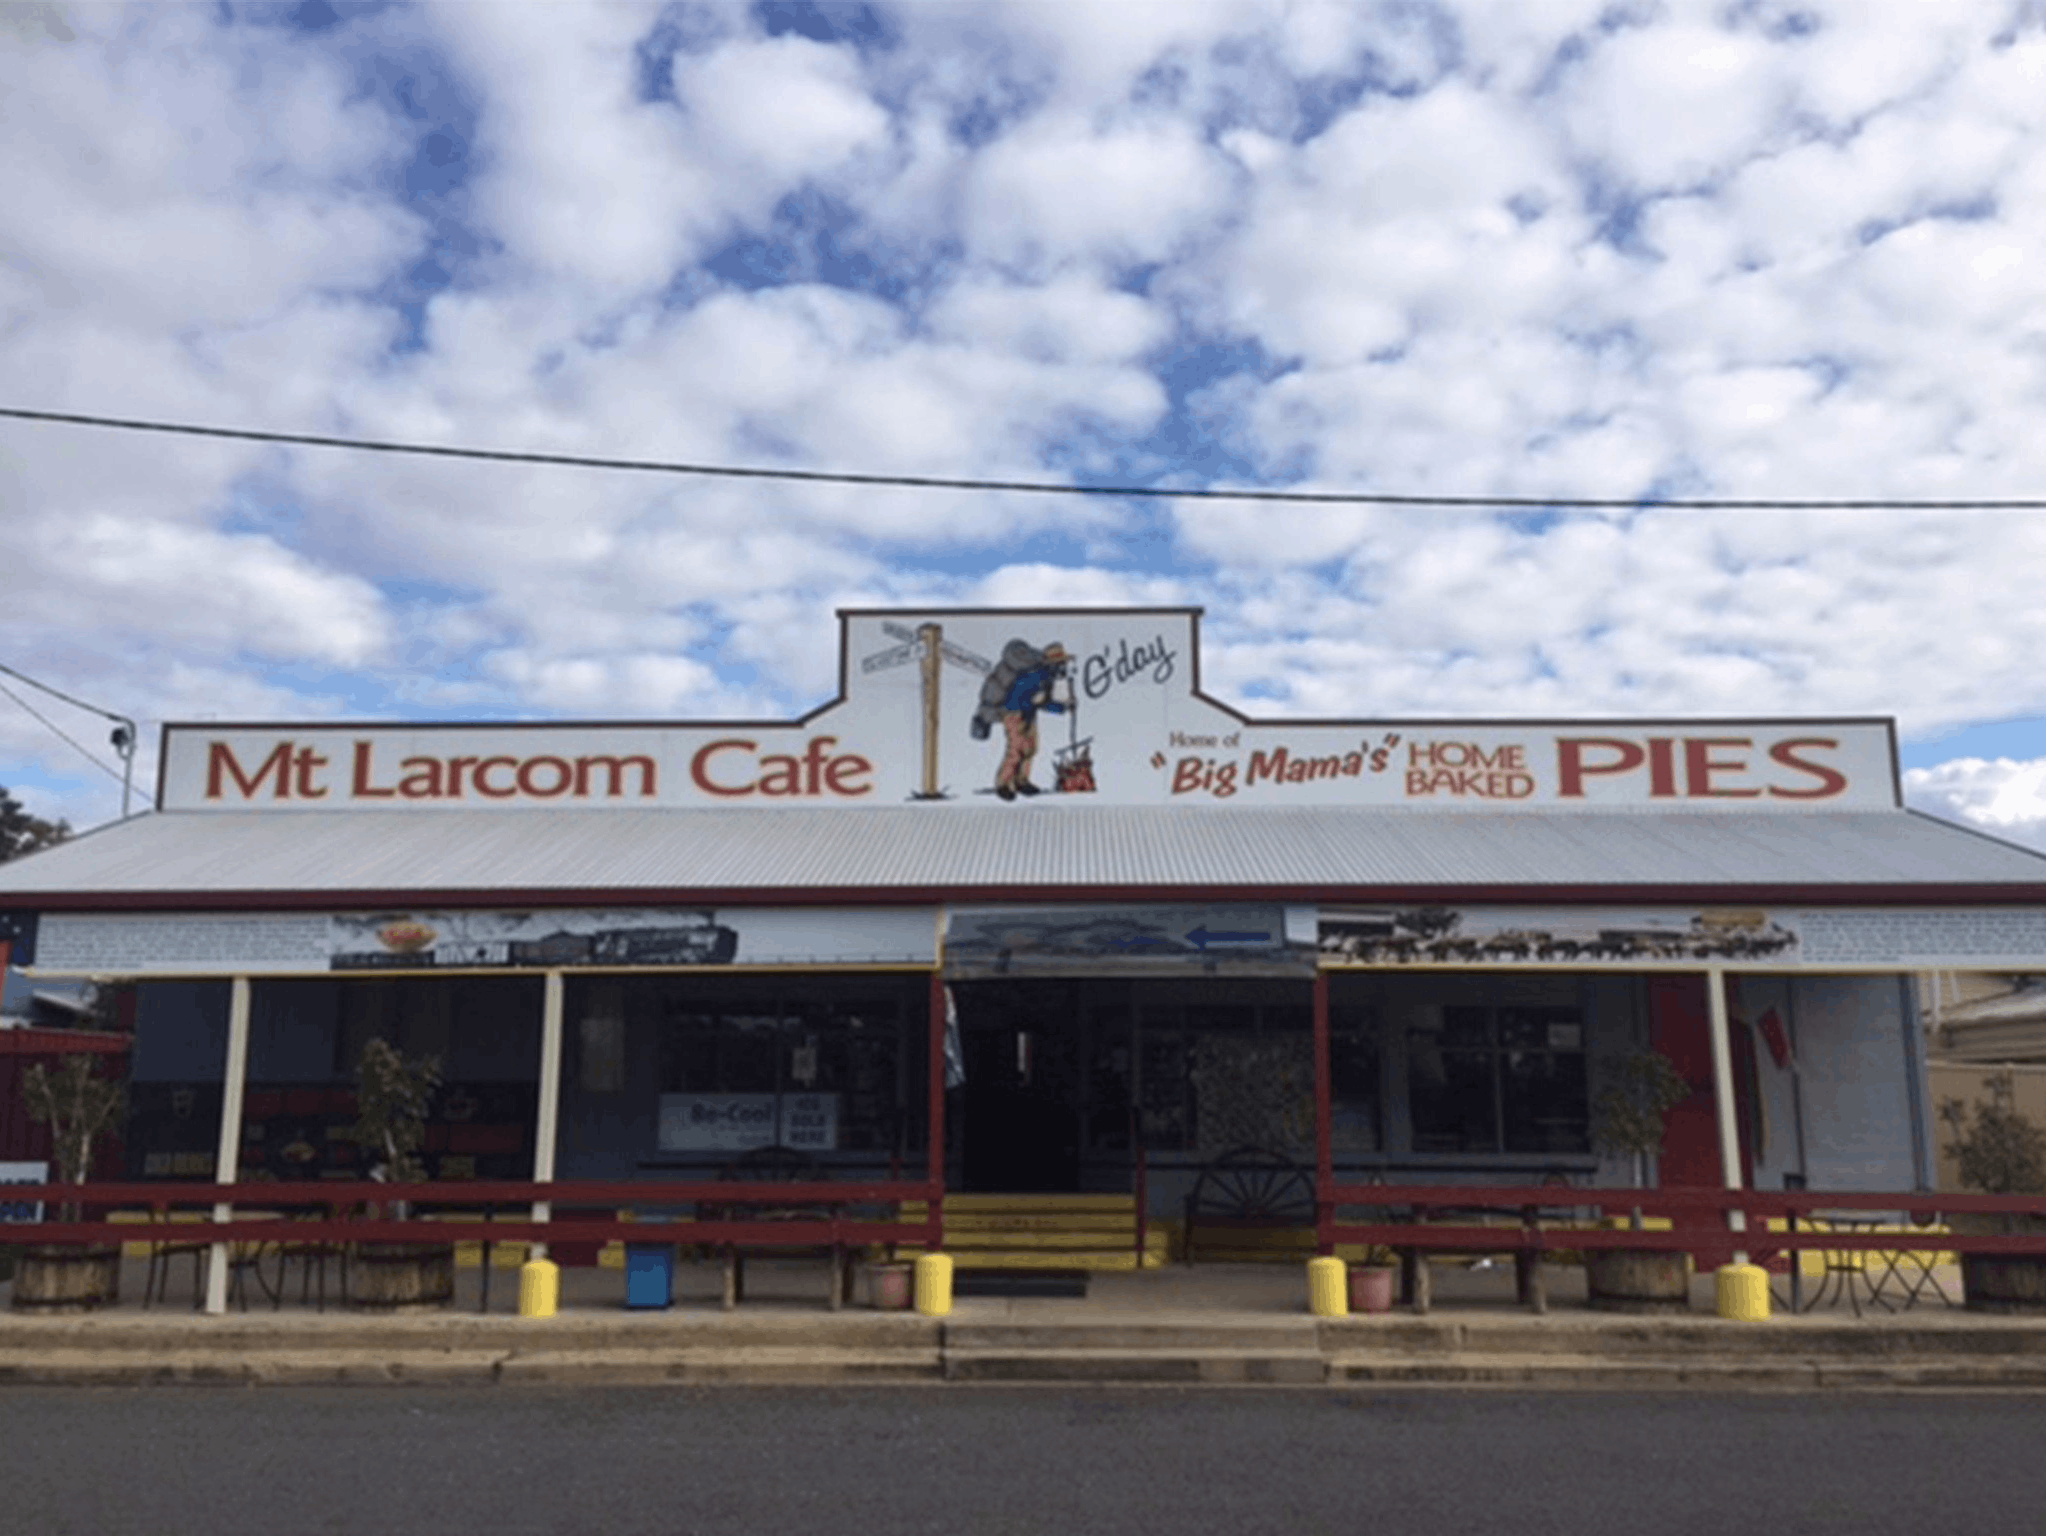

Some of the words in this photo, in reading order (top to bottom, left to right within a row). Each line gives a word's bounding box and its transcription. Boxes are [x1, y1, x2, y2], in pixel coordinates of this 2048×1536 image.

[1083, 635, 1177, 699] G'day
[1169, 731, 1218, 748] Home
[1223, 730, 1241, 747] of
[1408, 741, 1526, 769] HOME
[203, 740, 329, 799] Mt
[352, 740, 657, 798] Larcom
[690, 736, 874, 798] Cafe
[1405, 768, 1536, 799] BAKED
[1556, 735, 1848, 799] PIES
